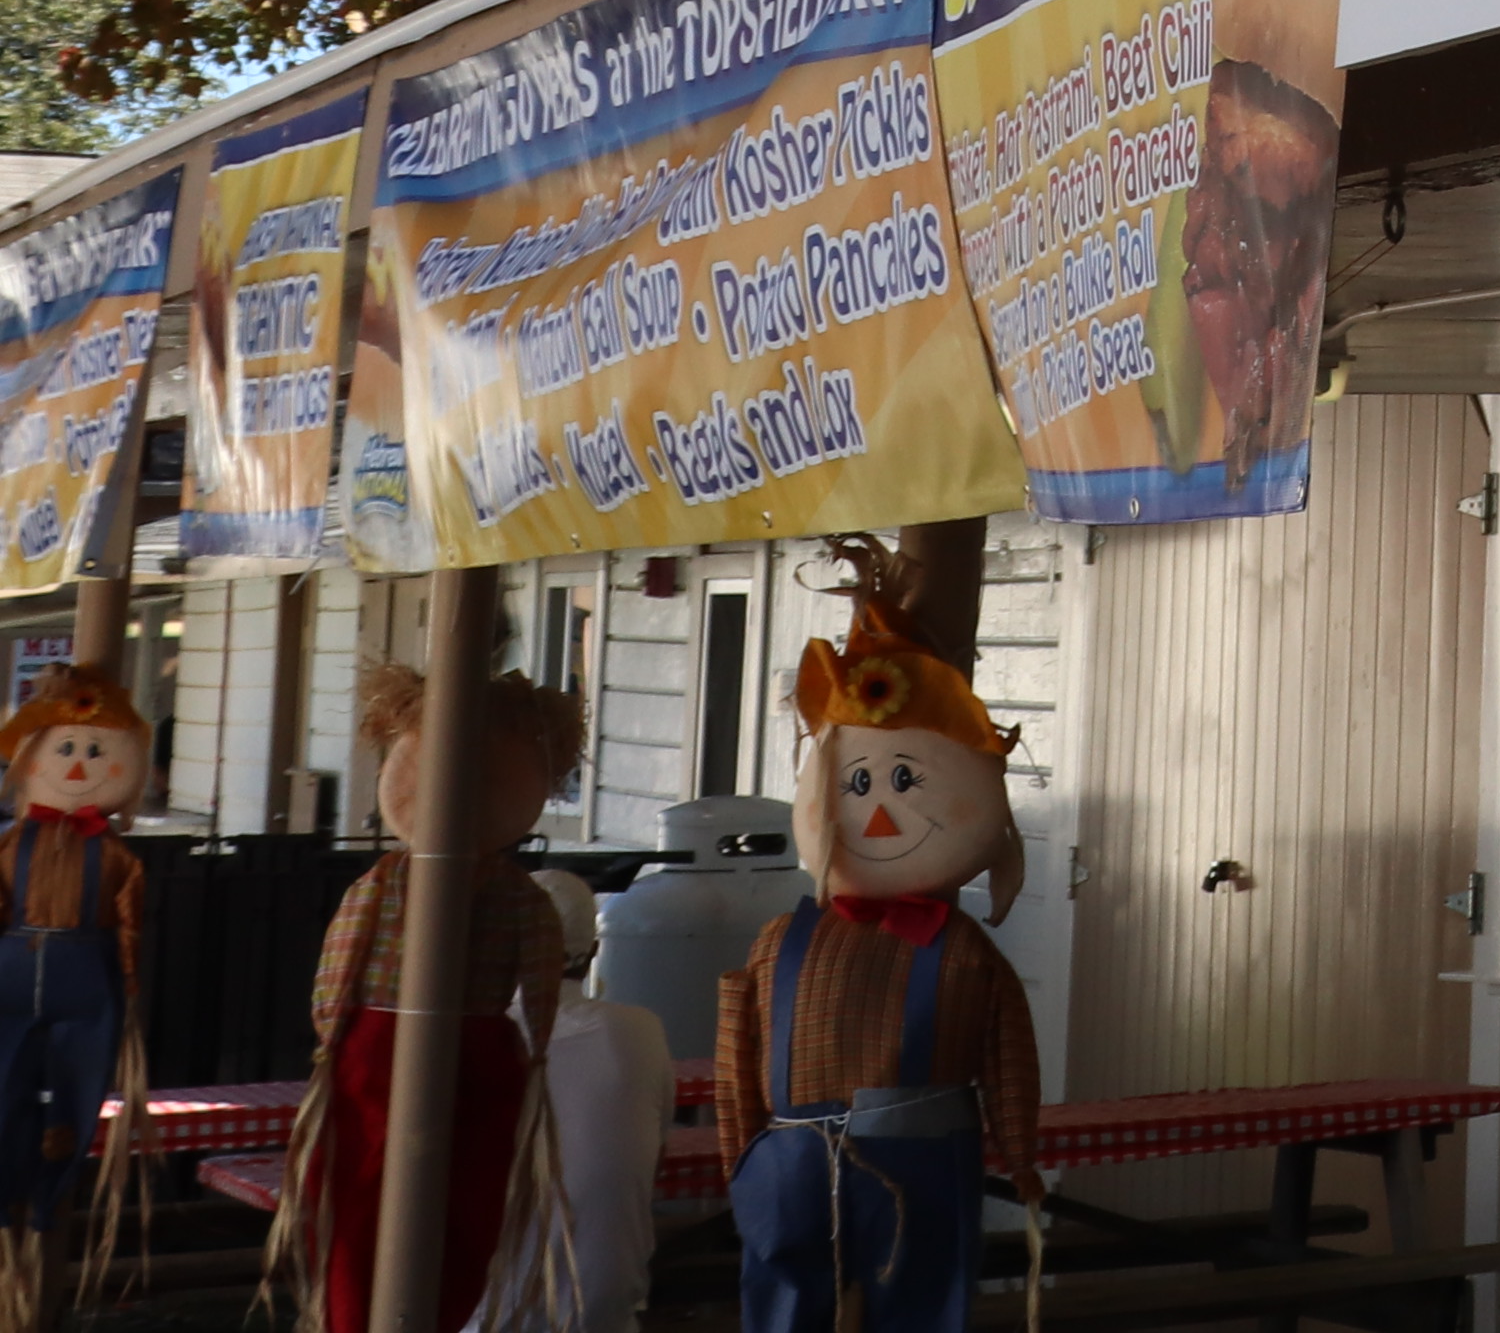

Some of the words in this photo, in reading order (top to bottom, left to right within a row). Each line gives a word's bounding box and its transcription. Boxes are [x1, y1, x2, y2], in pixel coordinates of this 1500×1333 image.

[605, 31, 632, 107] at
[635, 14, 675, 99] the
[994, 107, 1023, 193] Hot
[1101, 13, 1156, 119] Beef
[721, 103, 836, 225] Kosher
[832, 57, 934, 190] Pickles
[1036, 193, 1047, 258] a
[1048, 146, 1106, 253] Potato
[1108, 102, 1201, 215] Pancake
[581, 259, 626, 375] Ball
[621, 253, 684, 356] Soup
[711, 246, 808, 363] Potato
[803, 190, 950, 334] Pancakes
[1062, 230, 1116, 328] Bulkie
[1115, 207, 1157, 299] Roll
[565, 396, 651, 513] Kugel
[652, 390, 763, 507] Bagels
[746, 358, 823, 478] and
[806, 353, 867, 465] Lox
[1089, 312, 1156, 396] Spear.
